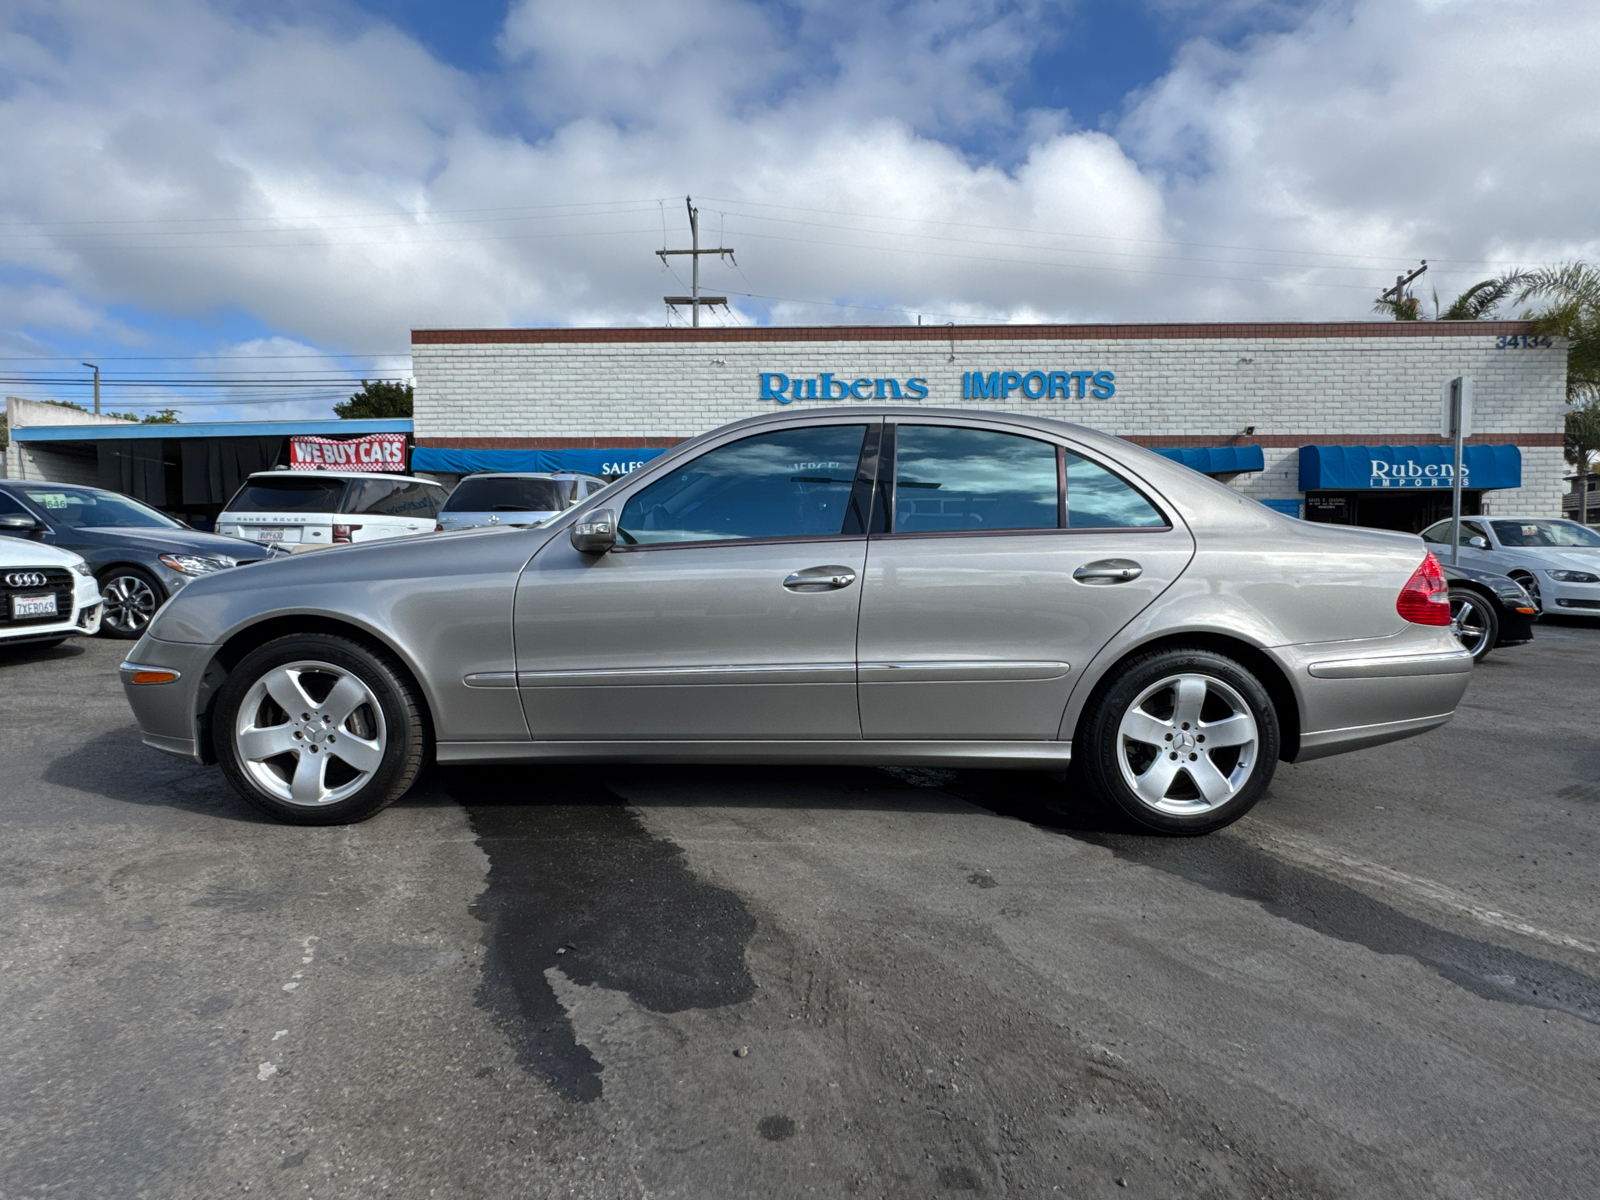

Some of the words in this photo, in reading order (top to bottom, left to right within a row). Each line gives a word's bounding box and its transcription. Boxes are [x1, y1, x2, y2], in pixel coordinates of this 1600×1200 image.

[1495, 334, 1553, 349] 34134
[759, 372, 929, 404] Rubens
[963, 371, 1116, 399] IMPORTS
[294, 442, 324, 463] WE
[321, 443, 357, 463] BUY
[359, 441, 402, 463] CARS
[1370, 460, 1470, 479] Rubens
